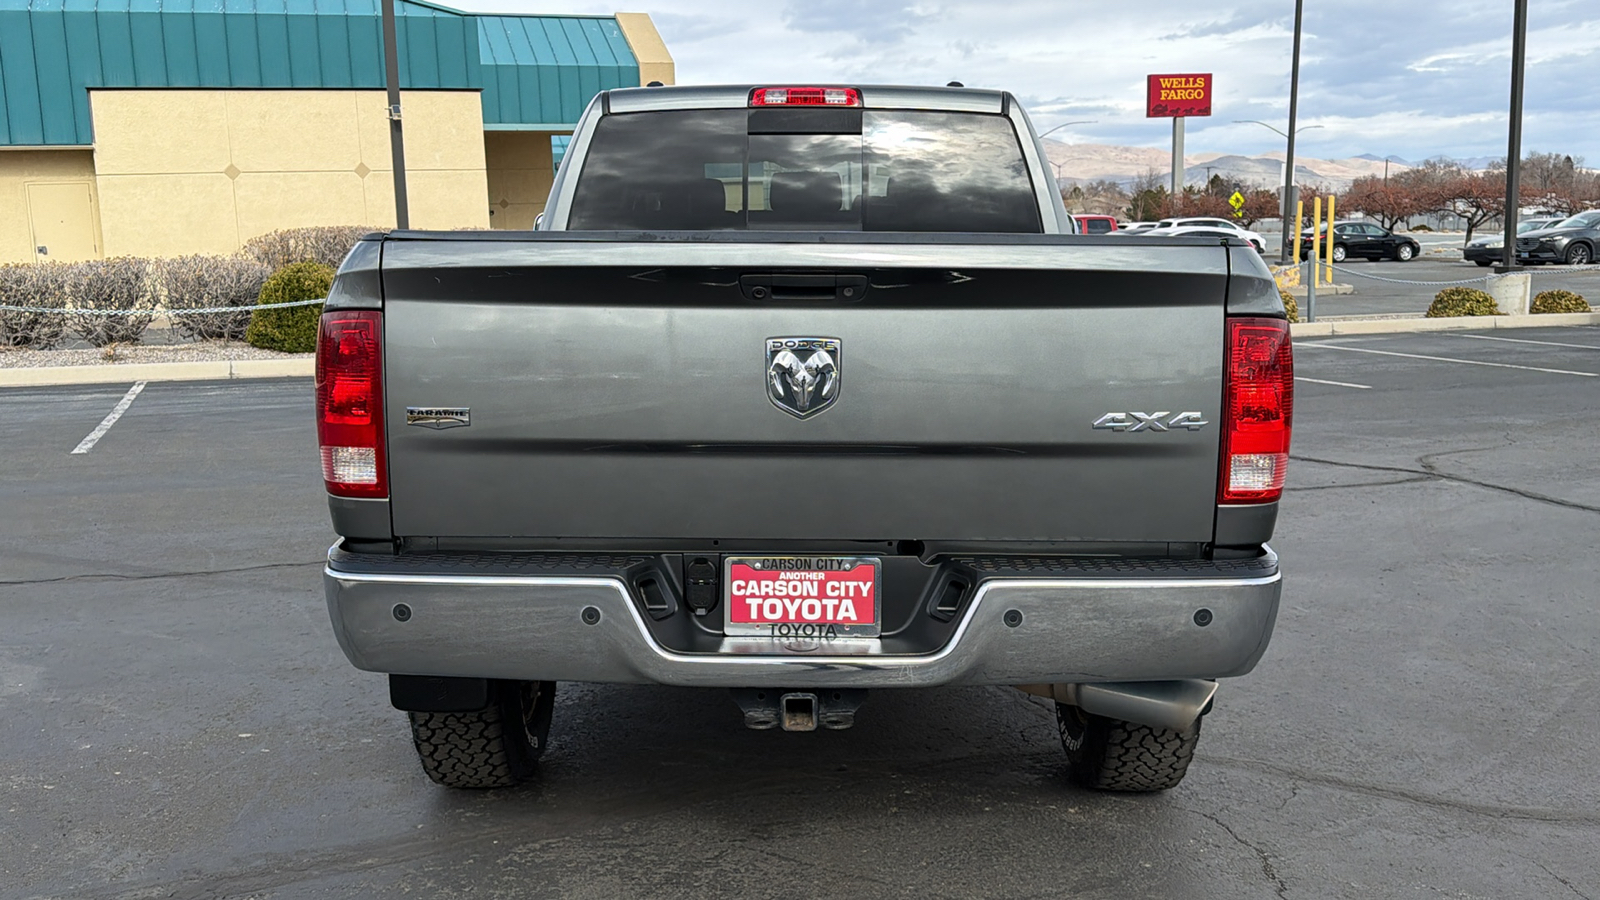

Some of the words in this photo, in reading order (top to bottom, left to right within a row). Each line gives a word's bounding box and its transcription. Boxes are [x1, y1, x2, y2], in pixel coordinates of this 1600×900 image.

[1159, 77, 1205, 88] WELLS
[1160, 88, 1205, 100] FARGO
[772, 340, 836, 350] DODGE
[762, 558, 810, 570] CARSON
[816, 558, 844, 570] CITY
[779, 572, 825, 580] ANOTHER
[731, 580, 818, 596] CARSON
[826, 581, 873, 597] CITY
[746, 598, 857, 620] TOYOTA
[768, 624, 837, 636] TOYOTA
